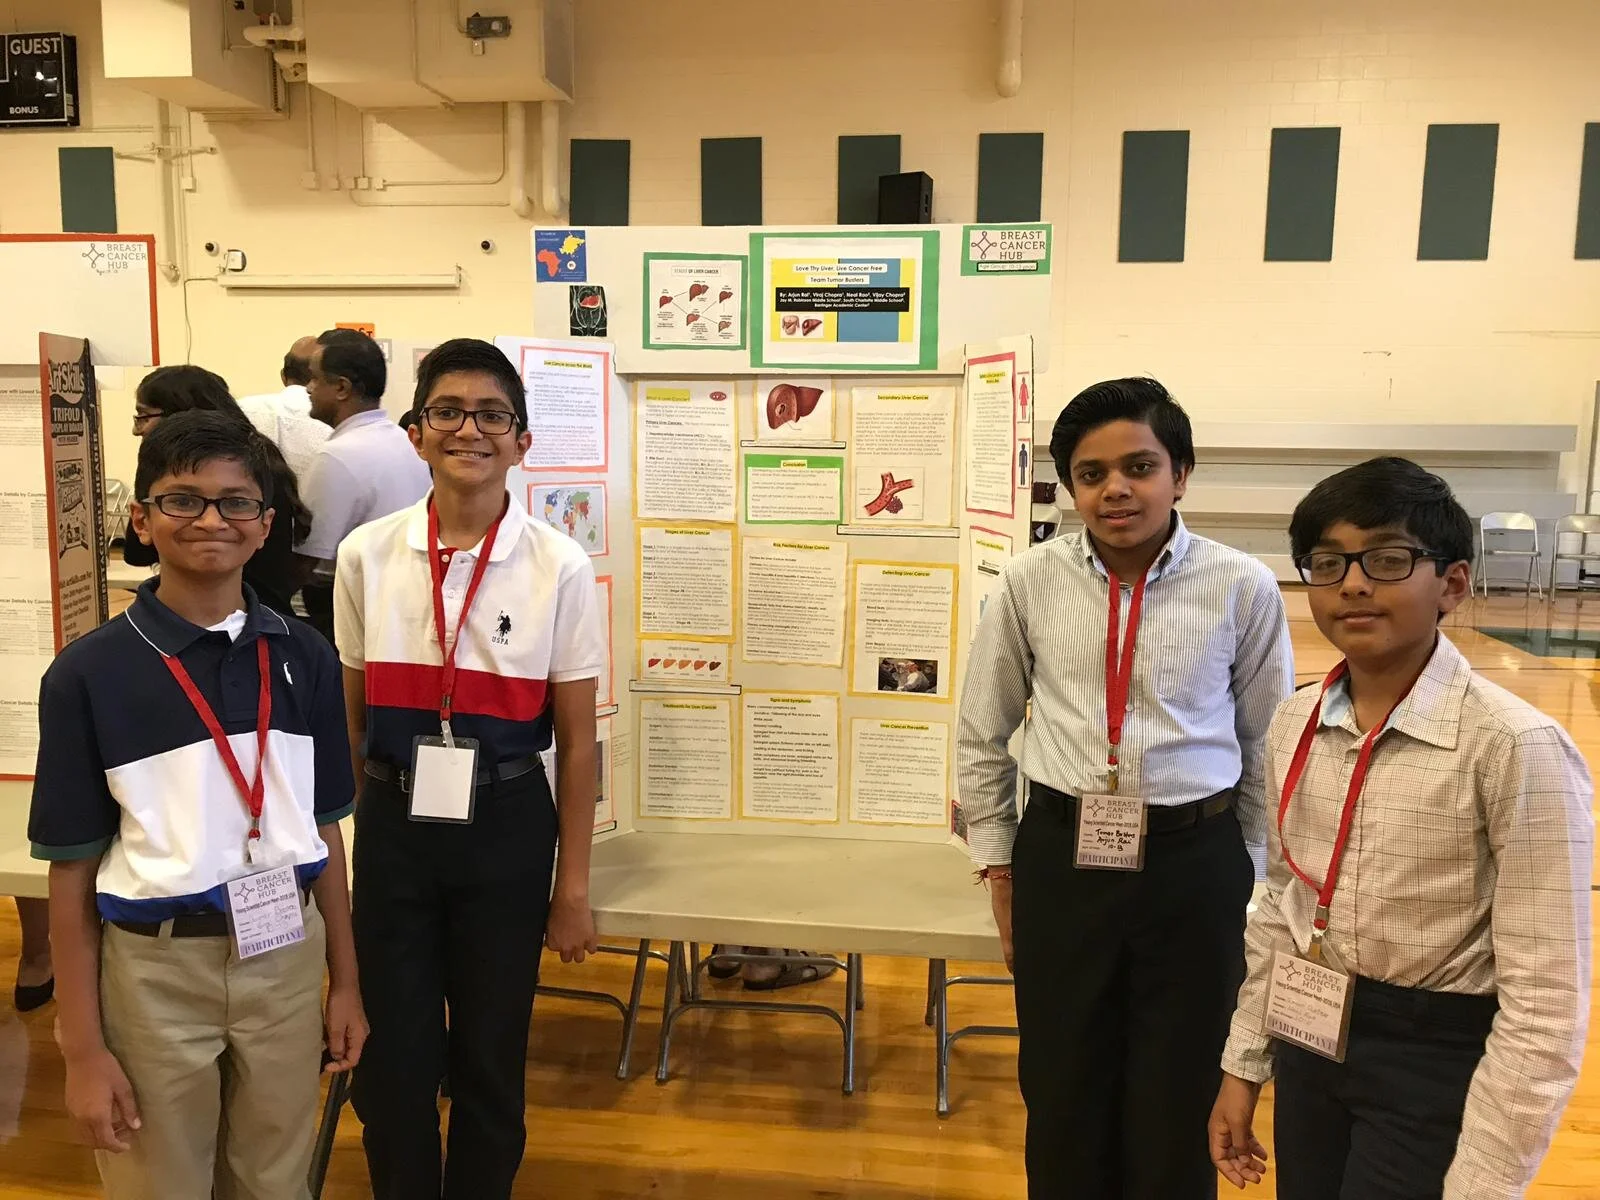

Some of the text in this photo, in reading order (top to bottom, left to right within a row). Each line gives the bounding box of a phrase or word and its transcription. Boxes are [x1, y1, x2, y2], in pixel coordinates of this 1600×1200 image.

[10, 38, 60, 55] GUEST
[9, 106, 39, 114] BONUS
[1000, 231, 1042, 240] BREAST
[106, 244, 143, 252] BREAST
[1000, 241, 1046, 250] CANCER
[107, 252, 147, 260] CANCER
[1000, 251, 1023, 260] HUB
[49, 360, 85, 394] ArtSkills
[52, 407, 80, 422] TRIFOLD
[492, 636, 508, 645] USPA
[1082, 854, 1134, 866] PARTICIPANT
[256, 871, 288, 885] BREAST
[256, 877, 292, 892] CANCER
[258, 889, 277, 899] HUB
[244, 930, 300, 954] PARTICIPANT
[1304, 966, 1340, 984] BREAST
[1302, 980, 1323, 993] HUB
[1304, 974, 1343, 993] CANCER
[1272, 1019, 1332, 1050] PARTICIPANT
